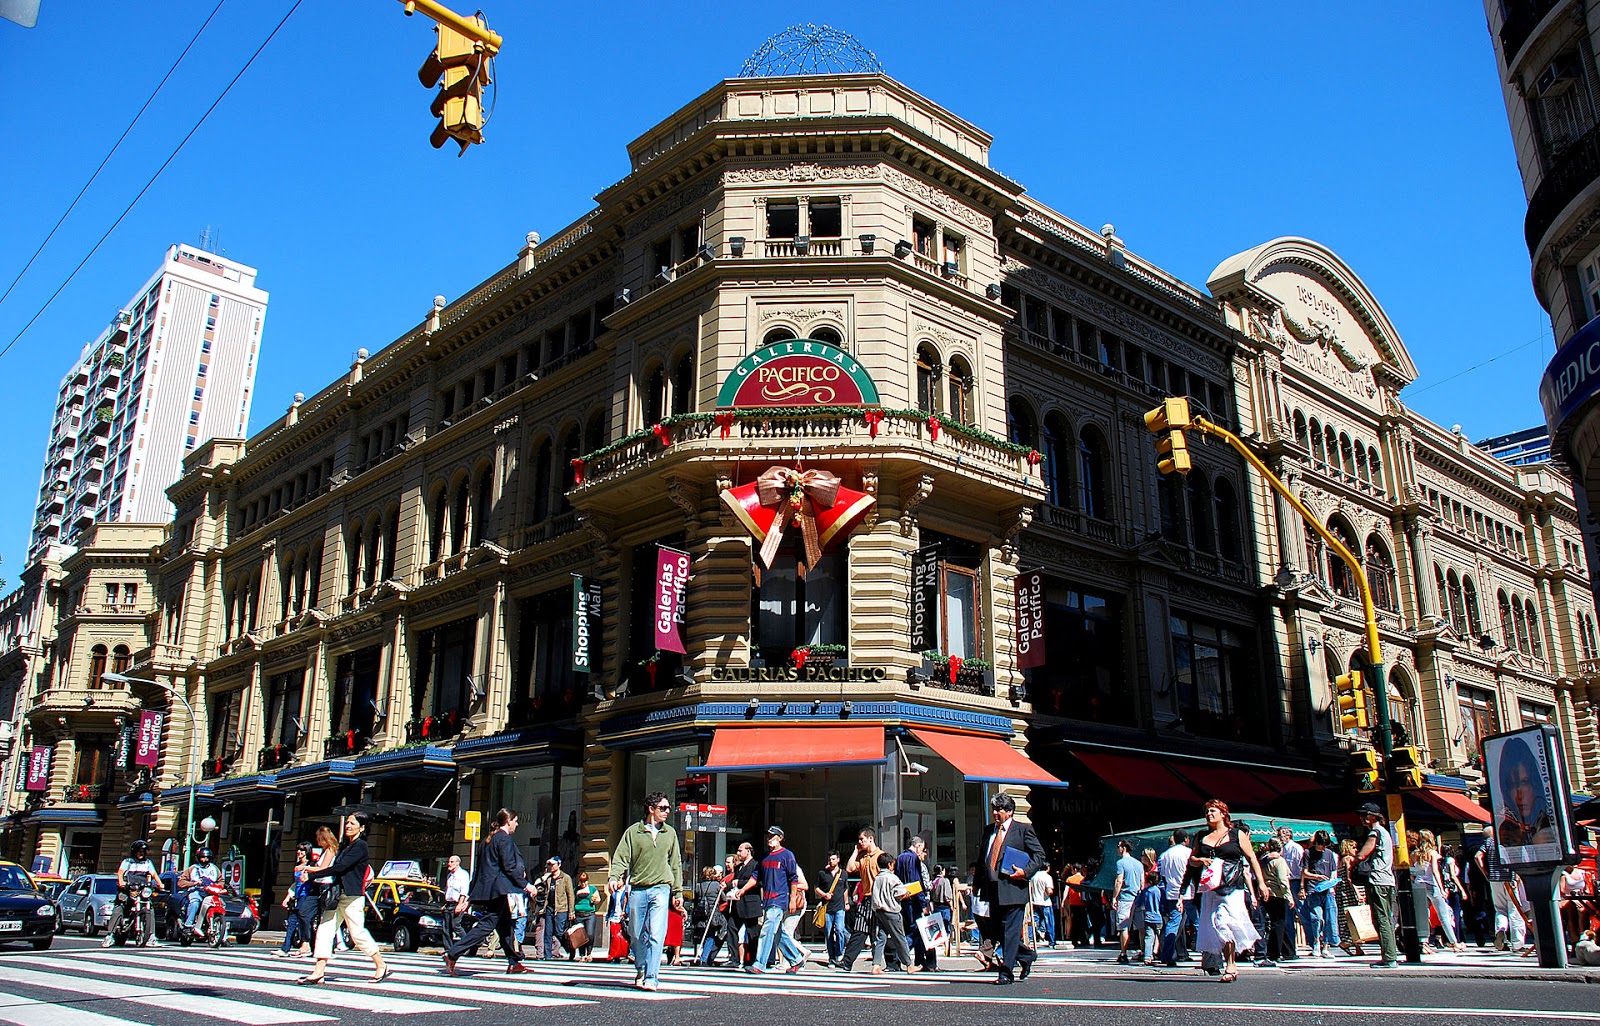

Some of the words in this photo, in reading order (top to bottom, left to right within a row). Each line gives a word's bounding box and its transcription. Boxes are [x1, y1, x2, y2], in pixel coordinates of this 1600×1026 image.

[736, 342, 860, 376] GALERIAS
[758, 366, 840, 387] PACIFICO
[1550, 341, 1600, 416] MEDIC
[925, 550, 937, 586] Mall
[590, 584, 601, 617] Mall
[657, 563, 674, 634] Galerías
[672, 557, 688, 624] Pacífico
[912, 564, 927, 646] Shopping
[1030, 575, 1043, 639] Pacífico
[574, 591, 591, 667] Shopping
[711, 667, 799, 681] GALERIAS
[806, 667, 887, 681] PACIFICO
[116, 727, 134, 768] Shopping
[149, 714, 162, 751] Pacífico
[1536, 734, 1549, 783] giordano
[921, 785, 961, 803] PRÜNE
[1544, 786, 1556, 826] roberto
